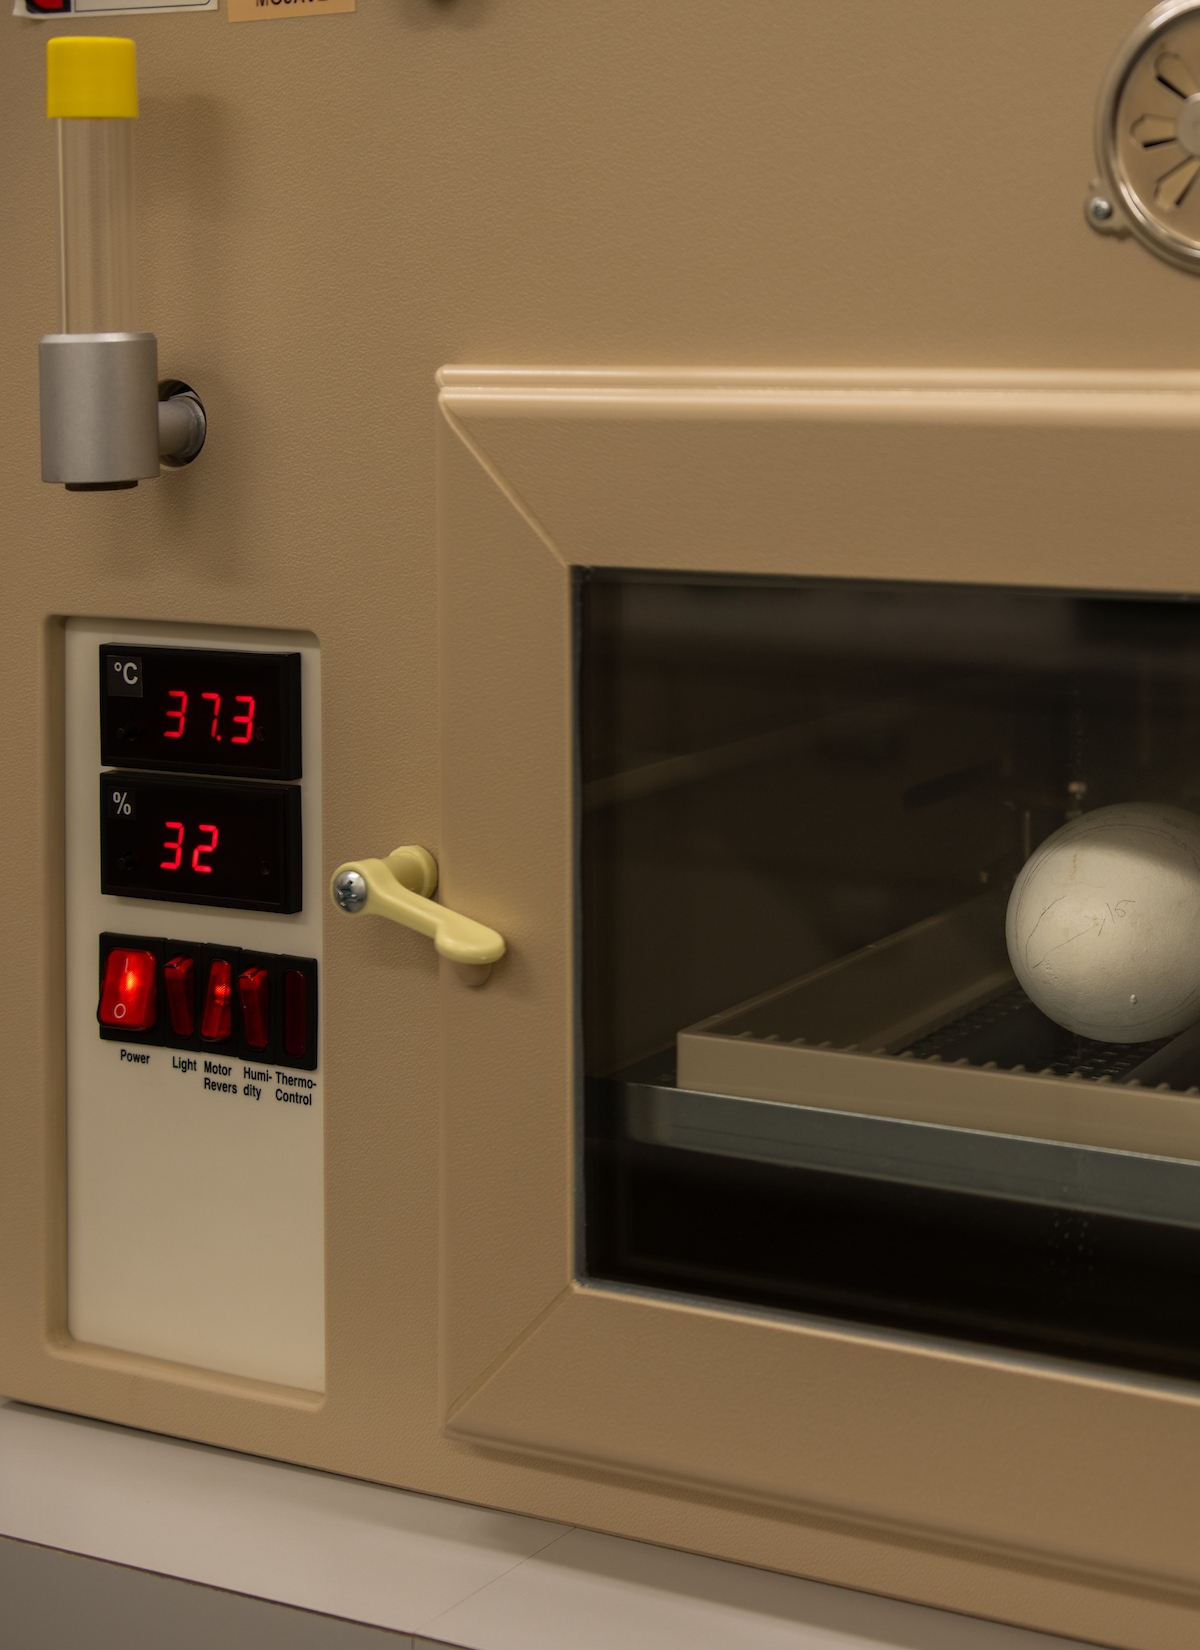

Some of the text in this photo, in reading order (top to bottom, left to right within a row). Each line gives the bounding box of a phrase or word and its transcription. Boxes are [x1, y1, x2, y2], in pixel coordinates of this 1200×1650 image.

[163, 690, 255, 743] 37.3
[160, 821, 219, 873] 32
[120, 1049, 150, 1064] Power
[172, 1056, 197, 1072] Light
[204, 1060, 232, 1076] Motor
[243, 1066, 272, 1082] Humi-
[204, 1078, 238, 1094] Revers
[275, 1071, 317, 1090] Thermo-
[243, 1084, 261, 1101] dity
[275, 1089, 312, 1106] Control
